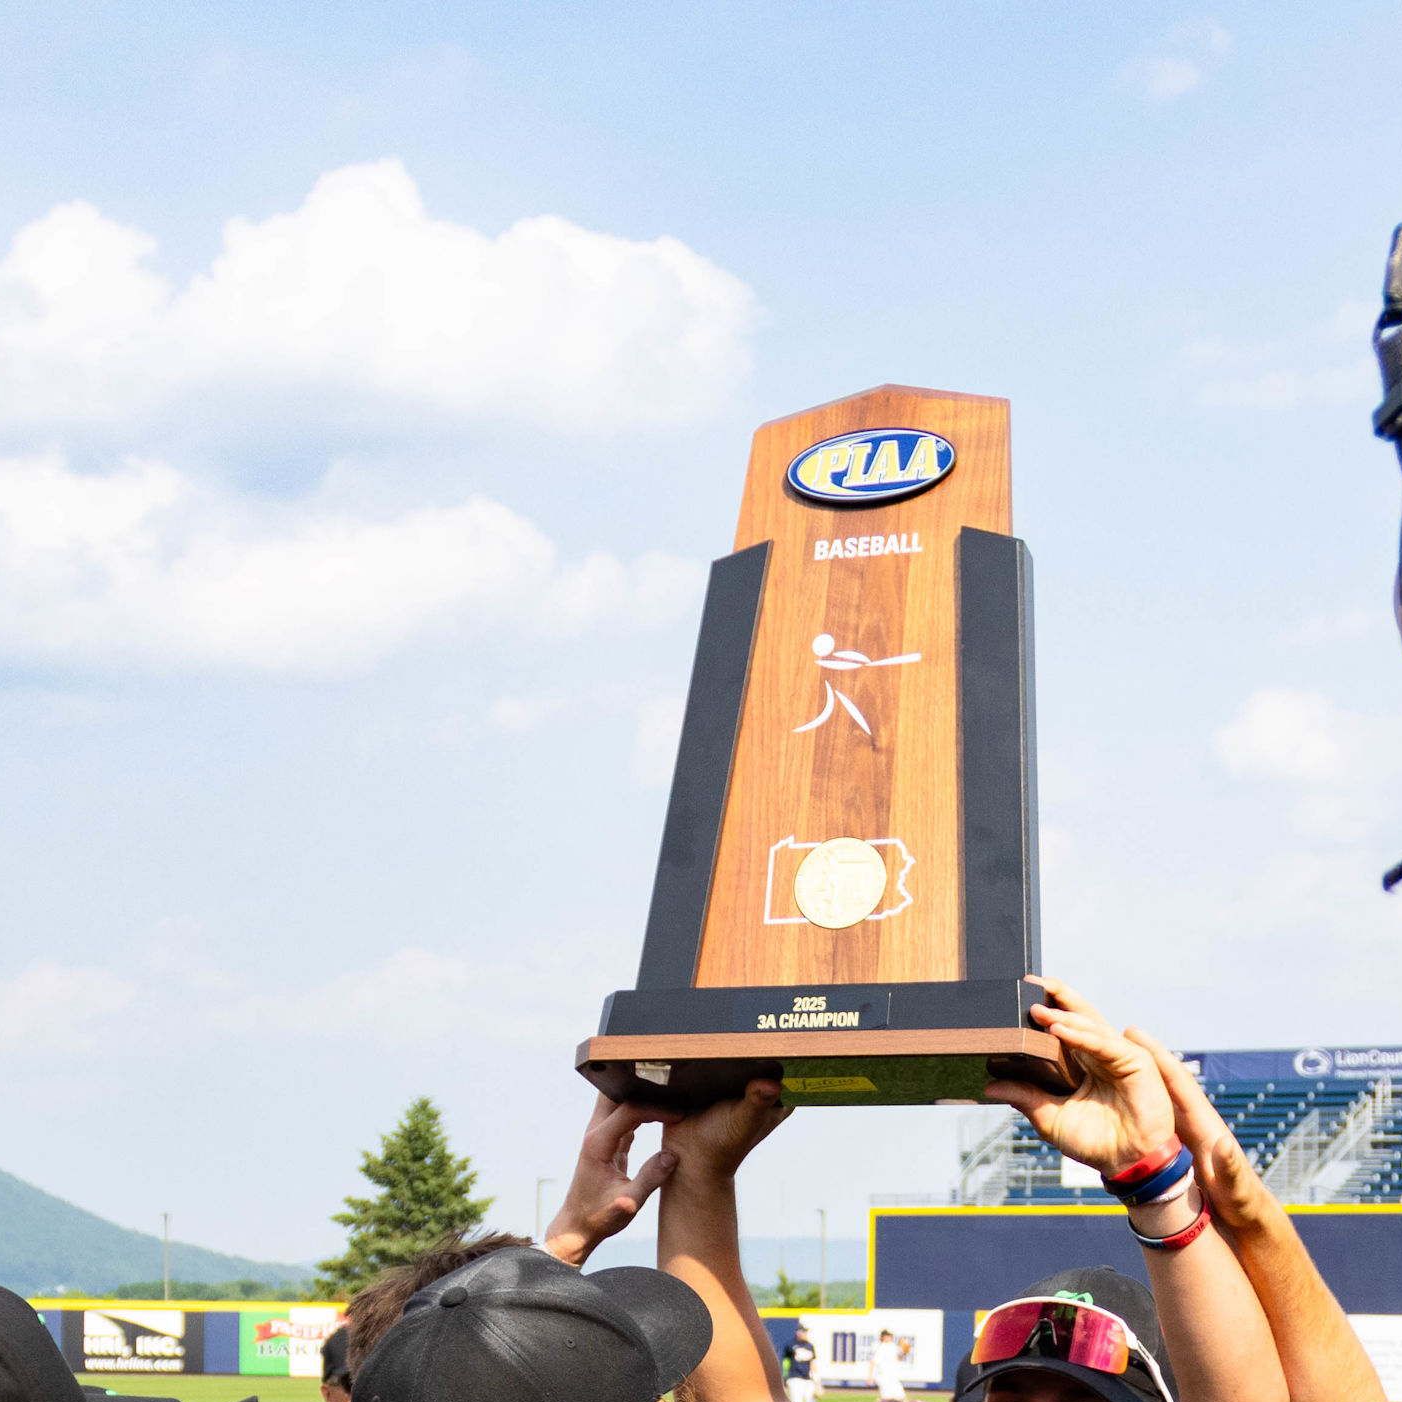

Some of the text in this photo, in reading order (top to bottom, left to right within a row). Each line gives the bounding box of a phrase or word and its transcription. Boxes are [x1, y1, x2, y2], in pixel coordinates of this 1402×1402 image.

[813, 436, 941, 490] PIAA
[814, 532, 924, 561] BASEBALL
[792, 996, 827, 1012] 2025
[757, 1011, 860, 1030] 3A CHAMPION
[135, 1335, 186, 1356] INC.
